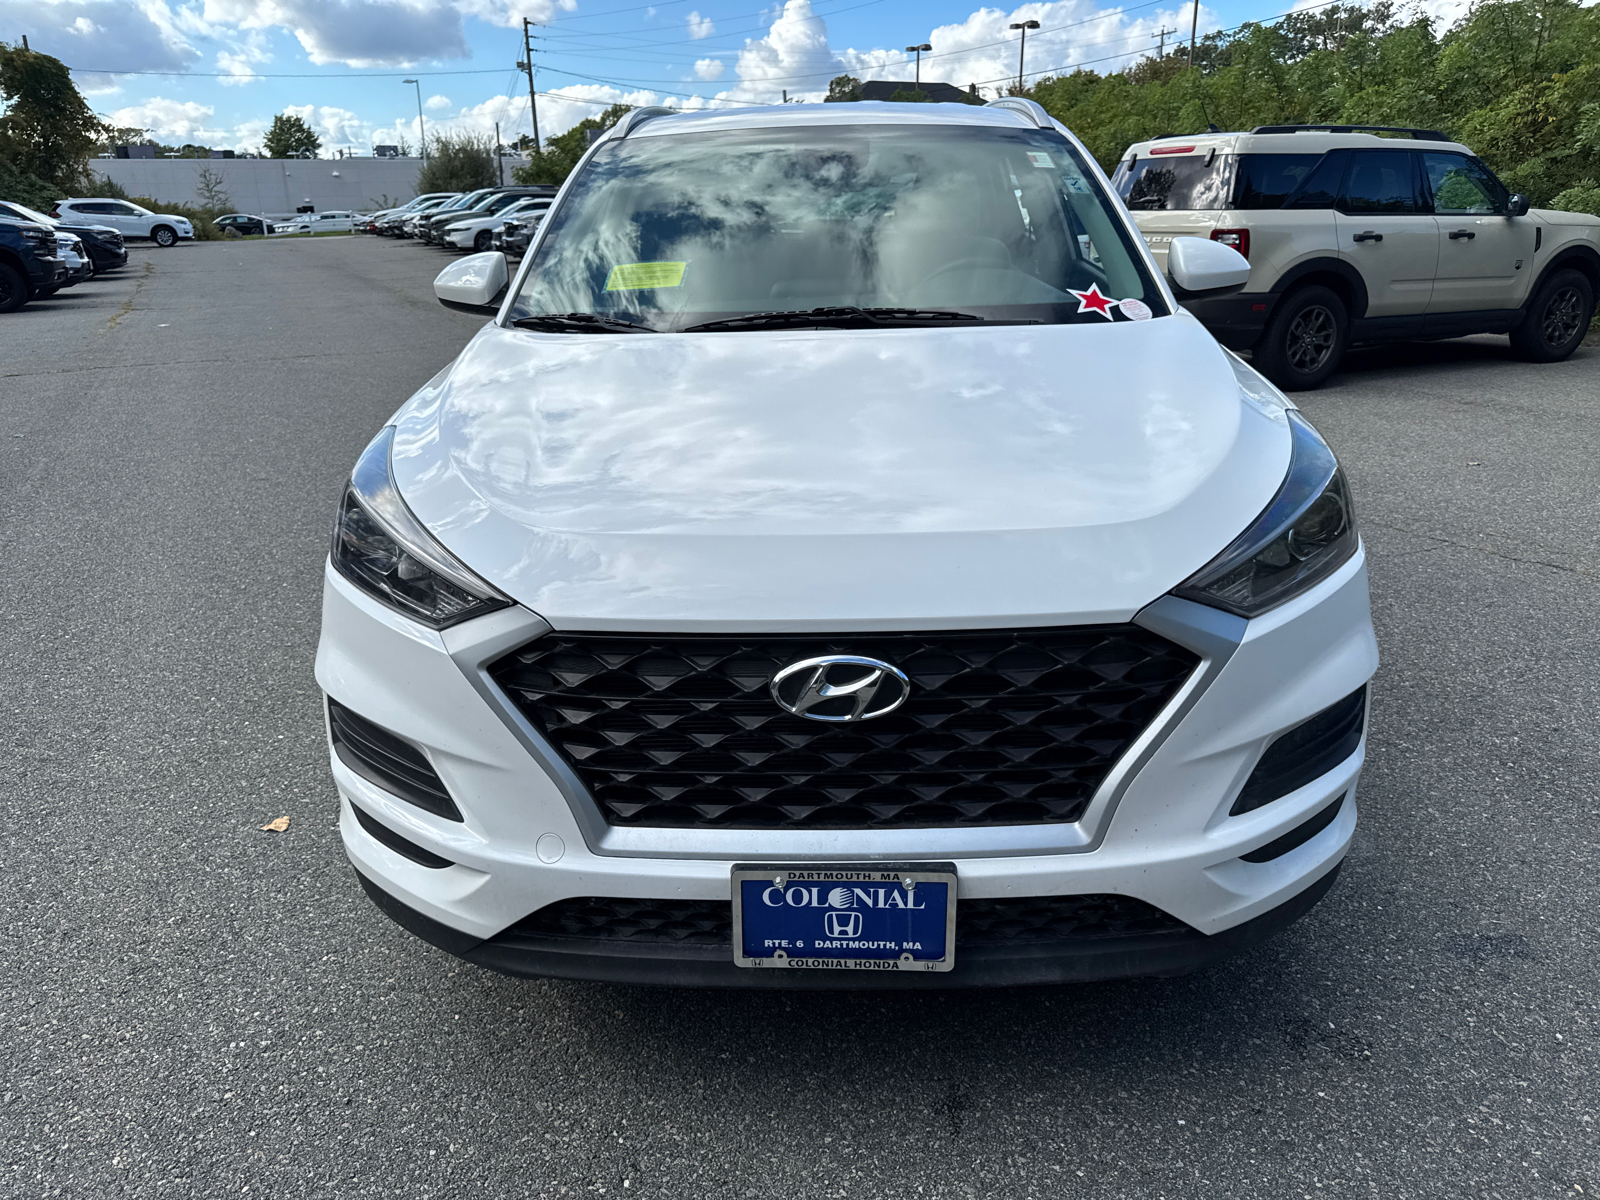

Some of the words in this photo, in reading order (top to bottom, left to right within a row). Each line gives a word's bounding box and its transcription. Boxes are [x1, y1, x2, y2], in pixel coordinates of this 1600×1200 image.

[880, 873, 901, 881] MA
[762, 886, 926, 910] COLONIAL
[764, 939, 793, 948] RTE.
[796, 940, 804, 948] 6
[815, 940, 899, 950] DARTMOUTH,
[902, 942, 922, 950] MA
[788, 959, 850, 968] COLONIAL
[854, 960, 900, 970] HONDA
